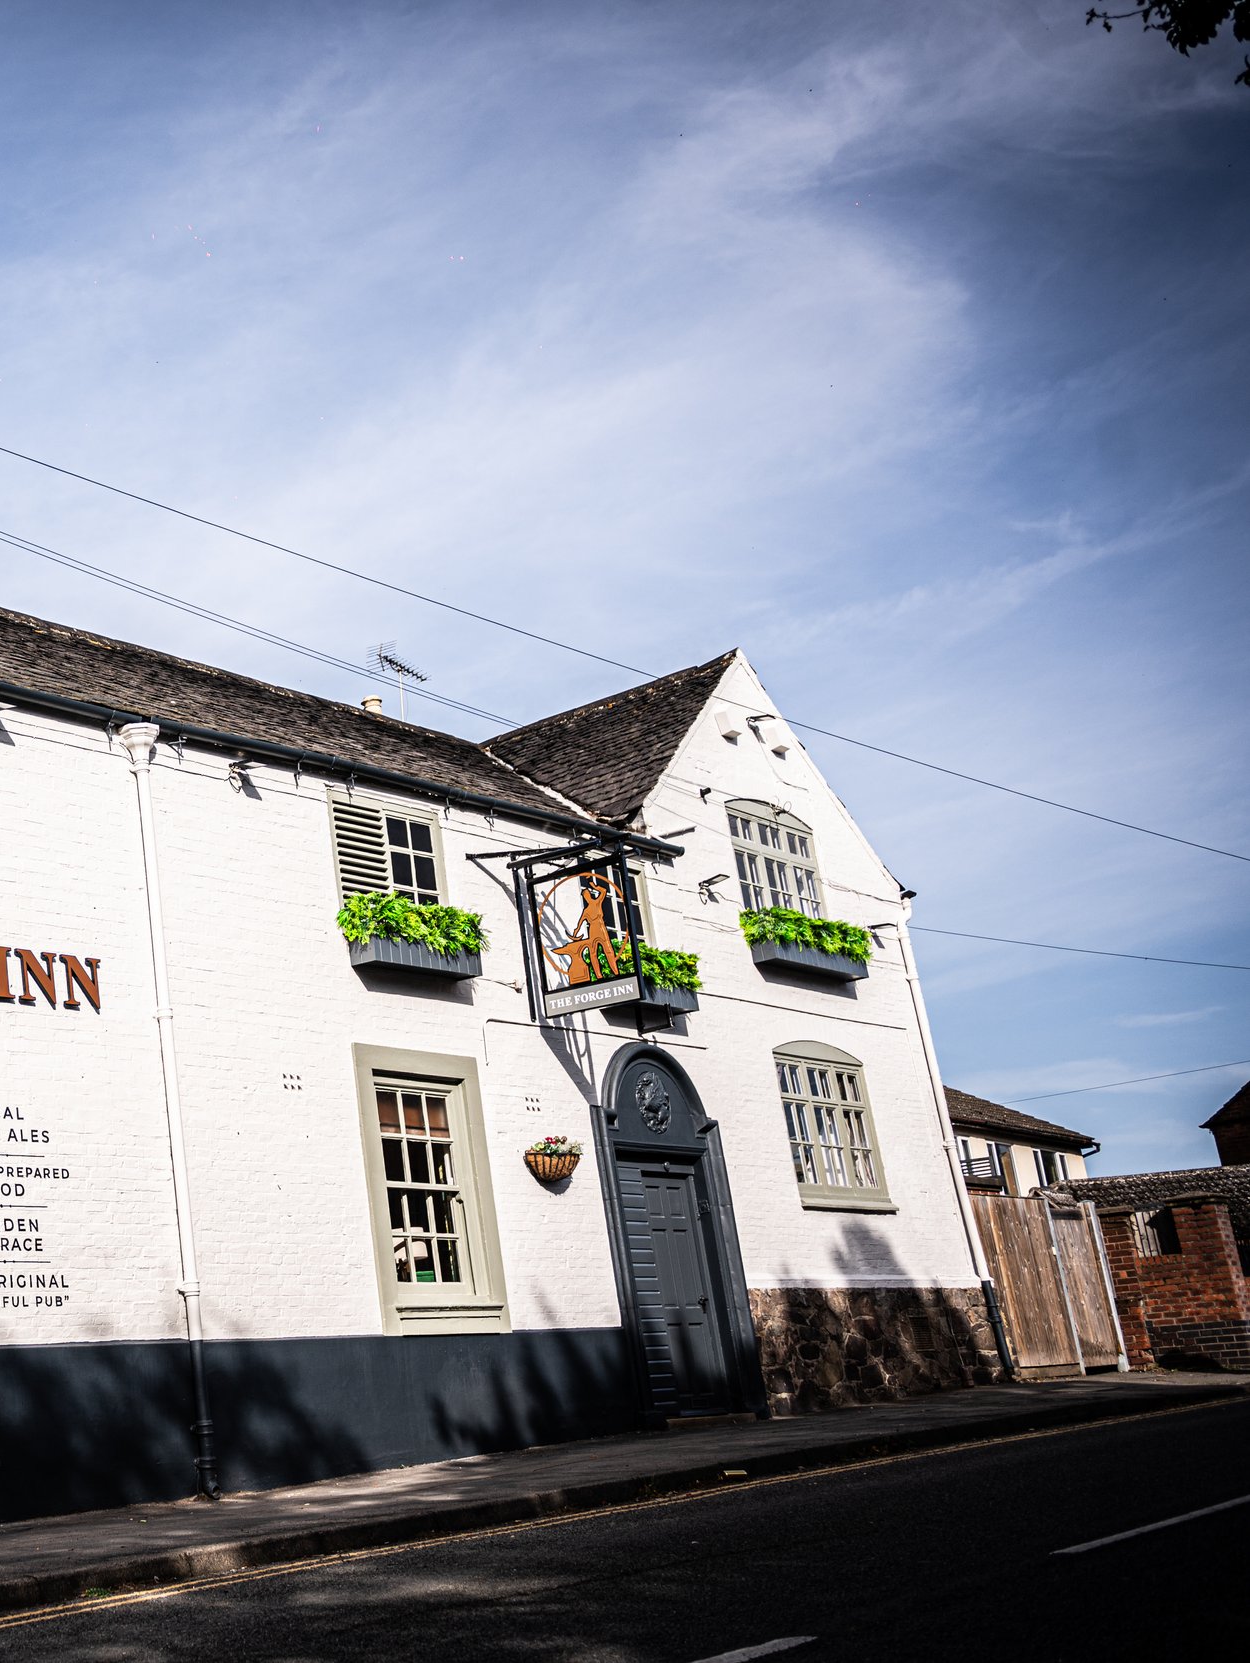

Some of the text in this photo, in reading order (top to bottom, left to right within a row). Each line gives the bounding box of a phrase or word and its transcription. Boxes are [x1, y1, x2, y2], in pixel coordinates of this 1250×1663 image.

[550, 984, 634, 1009] THE FORGE INN
[7, 1128, 50, 1143] ALES
